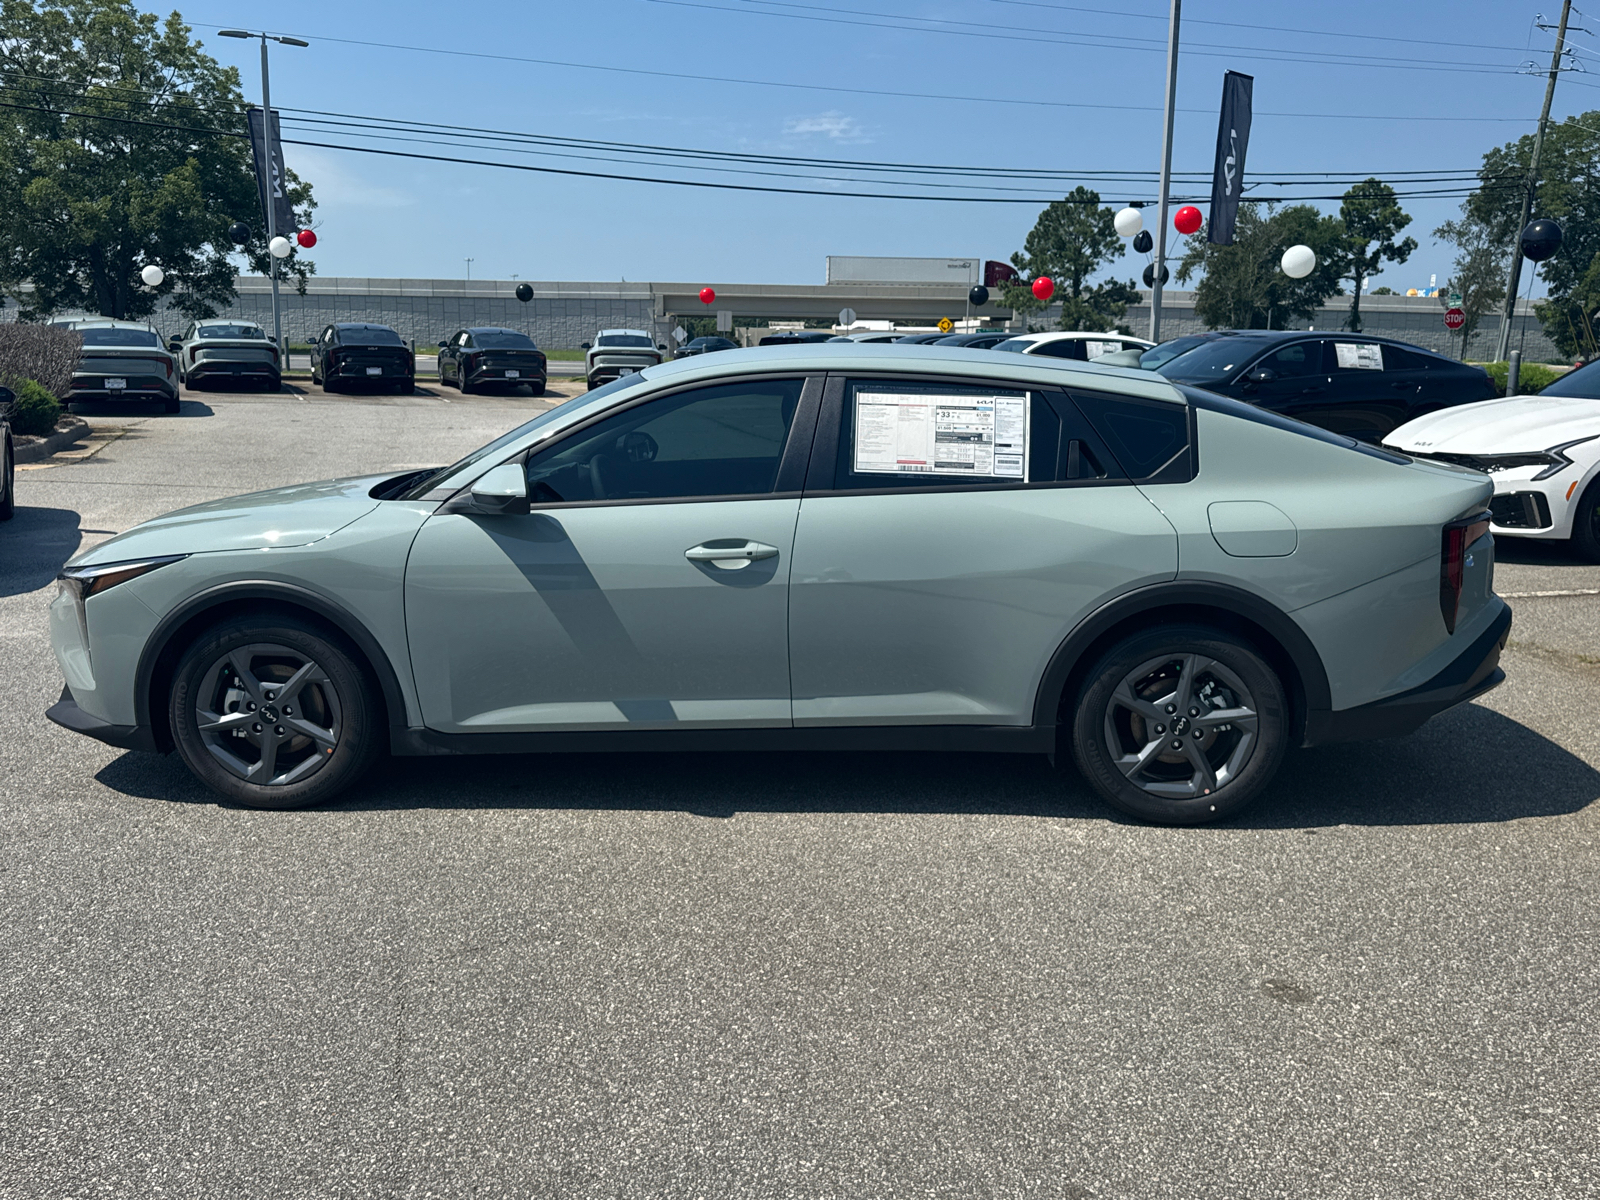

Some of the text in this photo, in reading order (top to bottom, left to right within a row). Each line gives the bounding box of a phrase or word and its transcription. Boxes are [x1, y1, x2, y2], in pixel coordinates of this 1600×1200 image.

[1445, 313, 1464, 323] STOP
[176, 681, 189, 741] KUMHO
[1087, 739, 1121, 794] KUMHO
